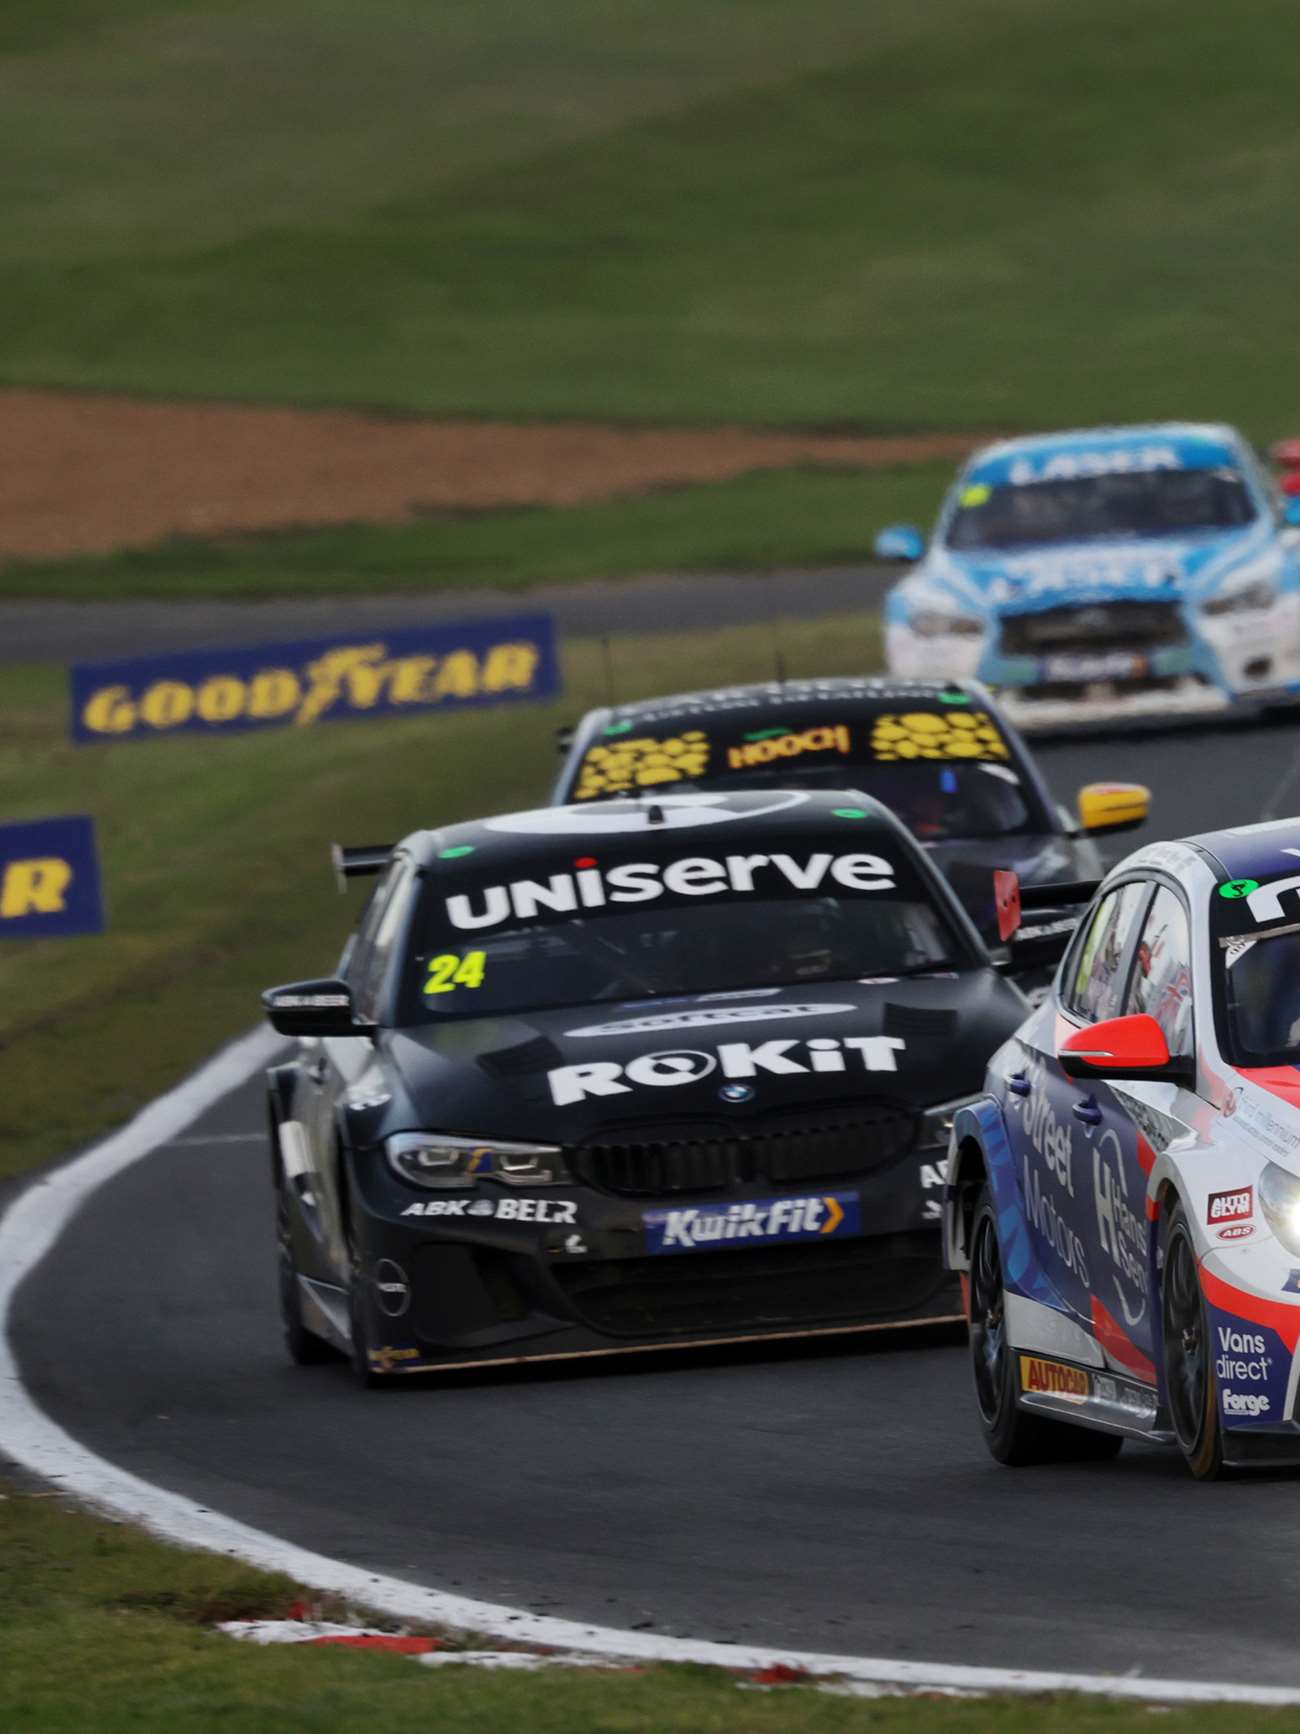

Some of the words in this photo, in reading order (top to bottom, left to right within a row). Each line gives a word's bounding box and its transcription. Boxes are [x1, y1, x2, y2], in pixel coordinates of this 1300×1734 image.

[83, 641, 540, 732] GOODYEAR
[424, 951, 486, 994] 24
[400, 1200, 471, 1216] ABK
[1222, 1226, 1251, 1237] ABS
[1217, 1327, 1265, 1353] Vans
[1216, 1355, 1268, 1380] direct
[1222, 1388, 1270, 1416] Forge
